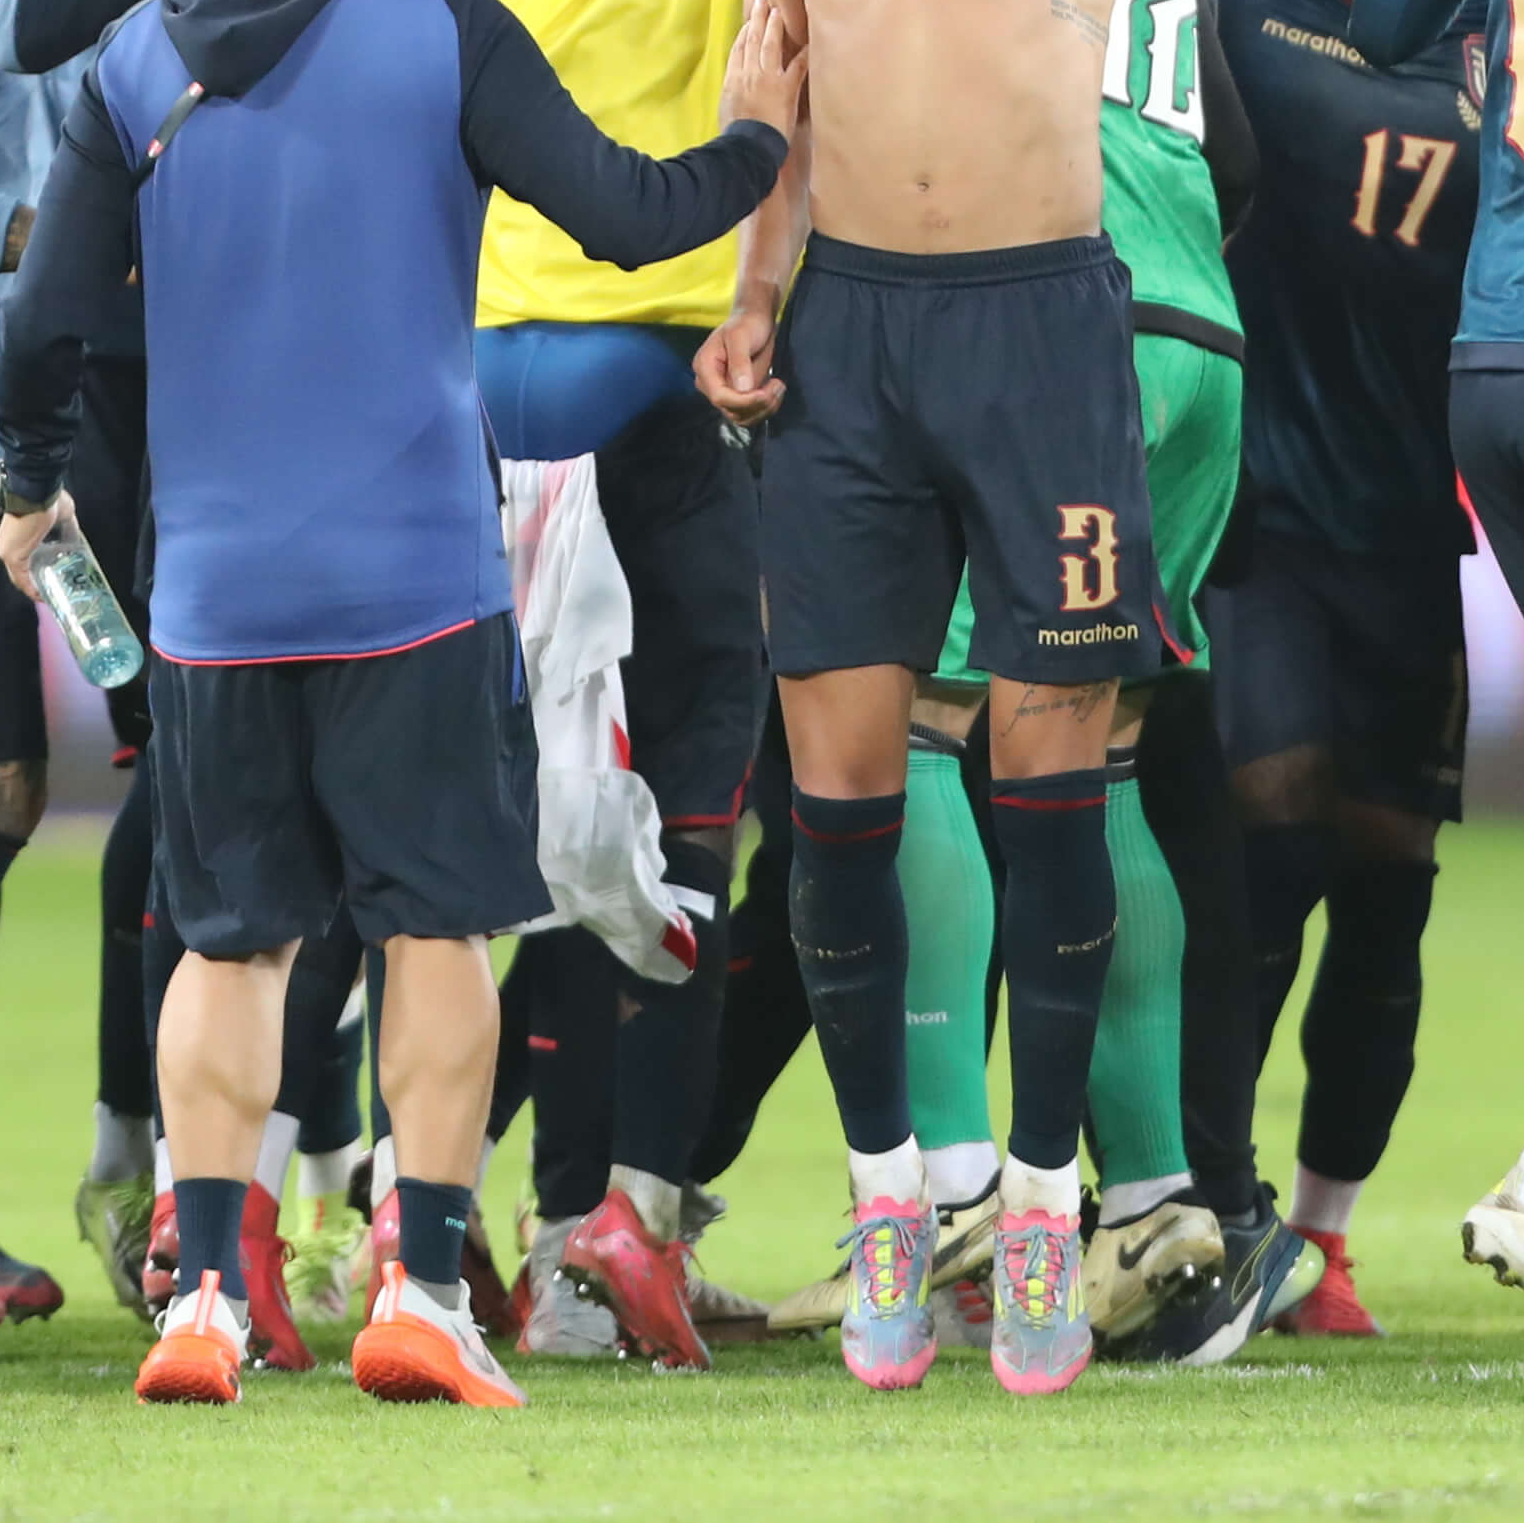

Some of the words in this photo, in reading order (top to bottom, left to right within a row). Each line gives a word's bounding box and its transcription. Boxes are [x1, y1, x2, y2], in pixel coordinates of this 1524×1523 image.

[1261, 17, 1369, 66] maratho
[1351, 126, 1459, 247] 17
[1056, 502, 1120, 613] 3
[1038, 621, 1139, 647] marathon
